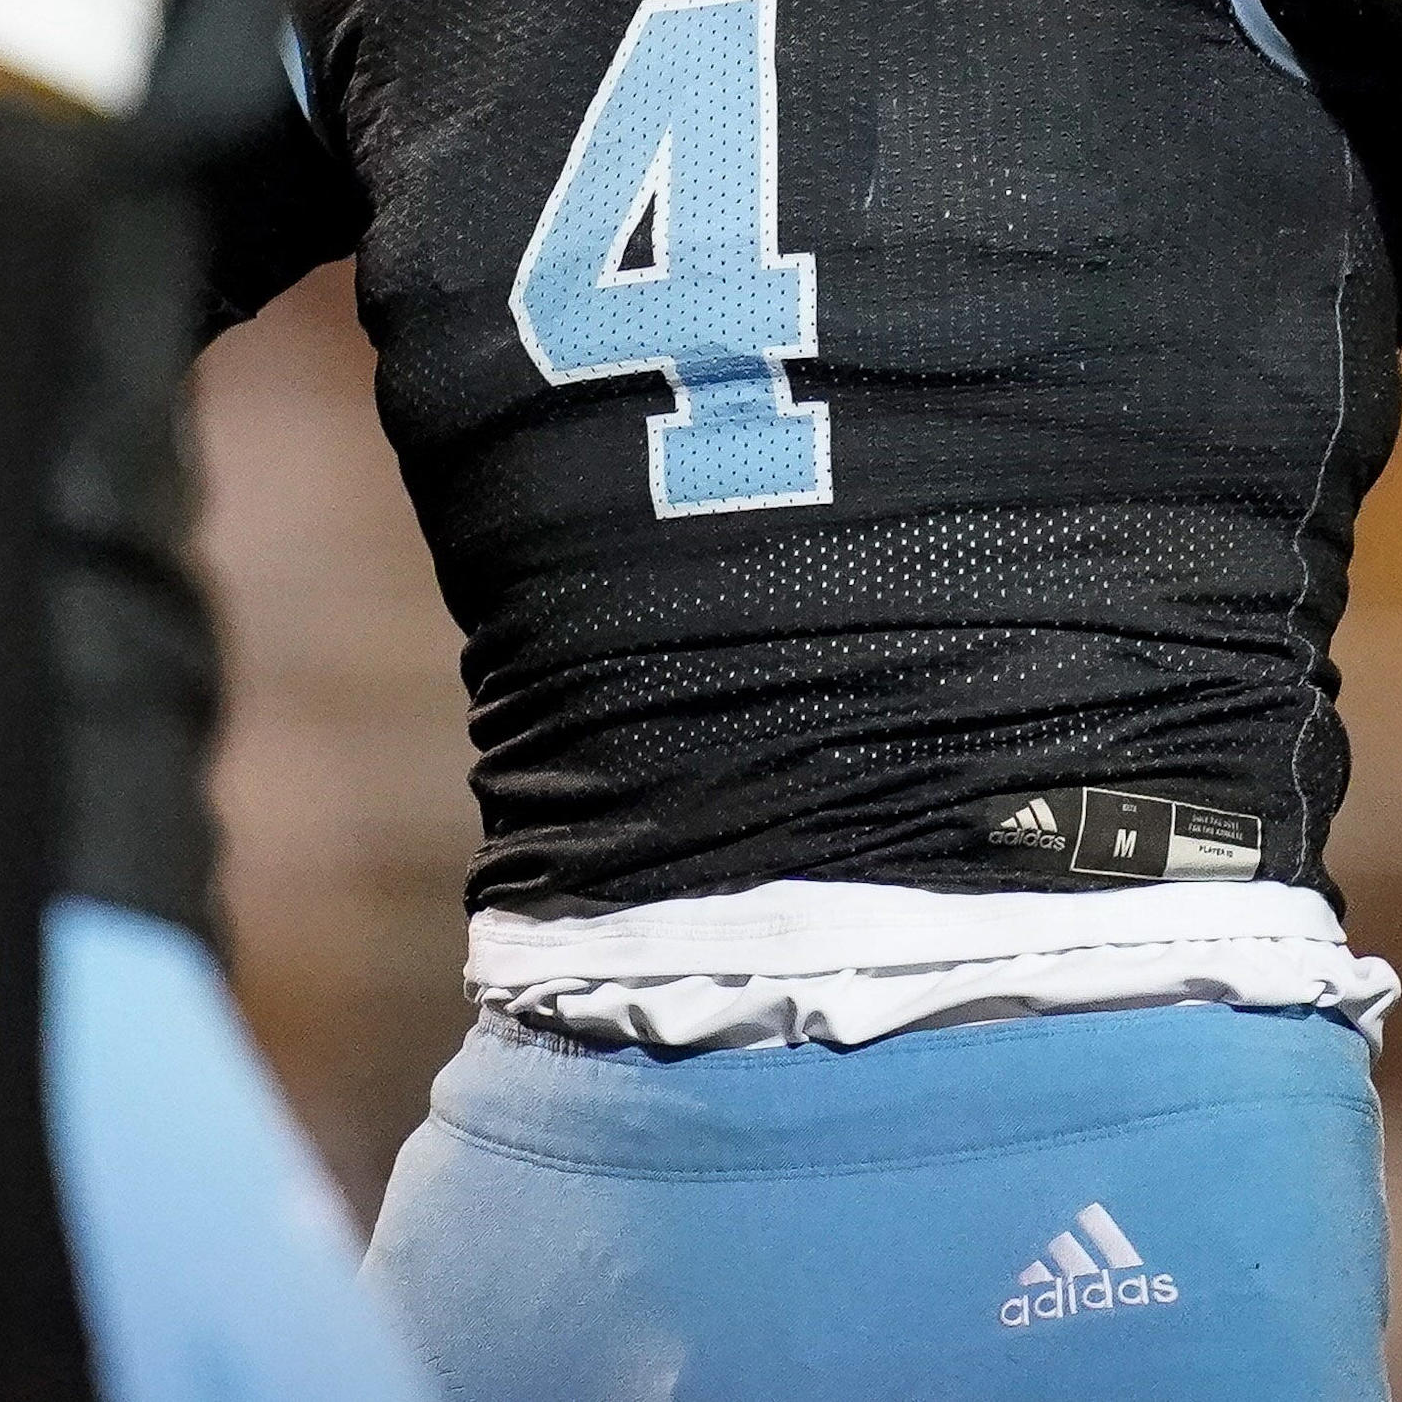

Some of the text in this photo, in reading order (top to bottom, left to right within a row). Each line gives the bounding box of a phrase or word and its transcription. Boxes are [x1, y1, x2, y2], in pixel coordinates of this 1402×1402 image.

[988, 826, 1066, 852] adidas
[1113, 828, 1138, 859] M
[1000, 1268, 1179, 1327] adidas
